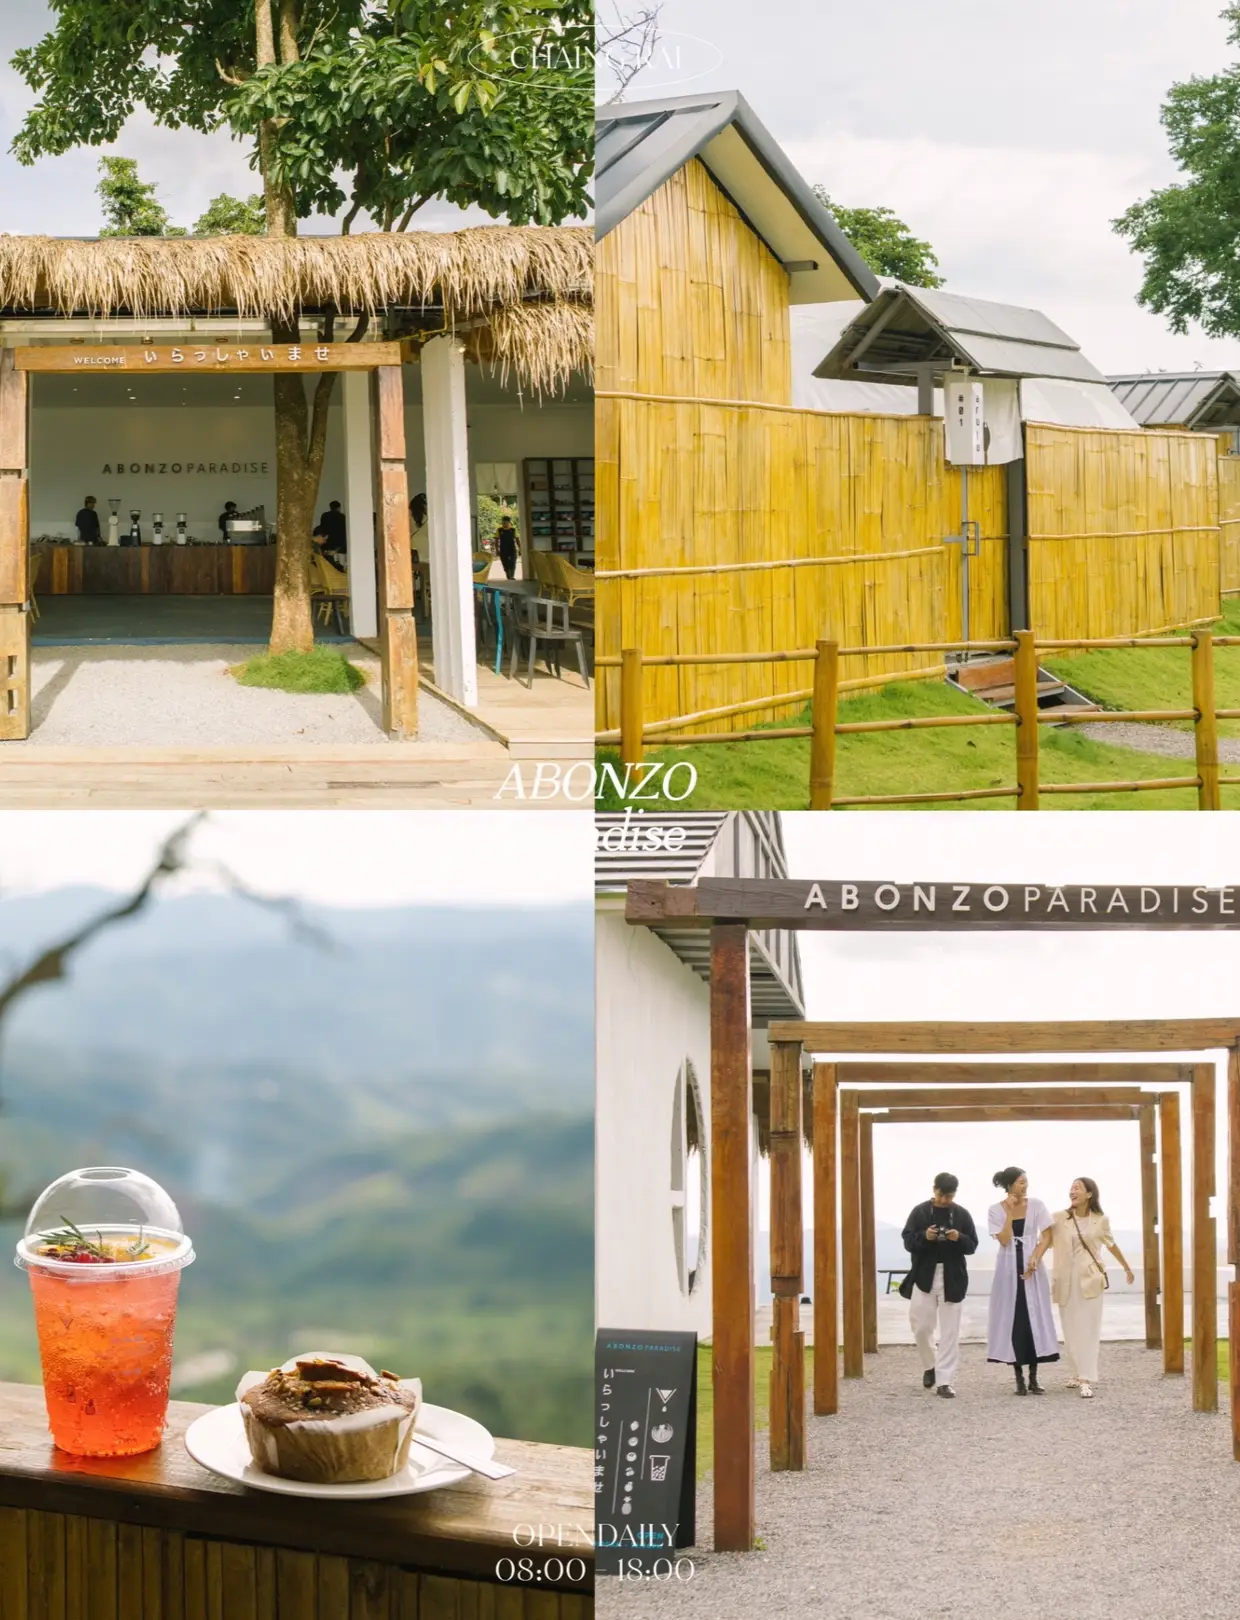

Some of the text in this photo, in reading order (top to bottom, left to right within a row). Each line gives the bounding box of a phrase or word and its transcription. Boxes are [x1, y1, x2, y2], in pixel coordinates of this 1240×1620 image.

[73, 355, 126, 365] WELCOME
[144, 347, 330, 363] いらっしゃいませ
